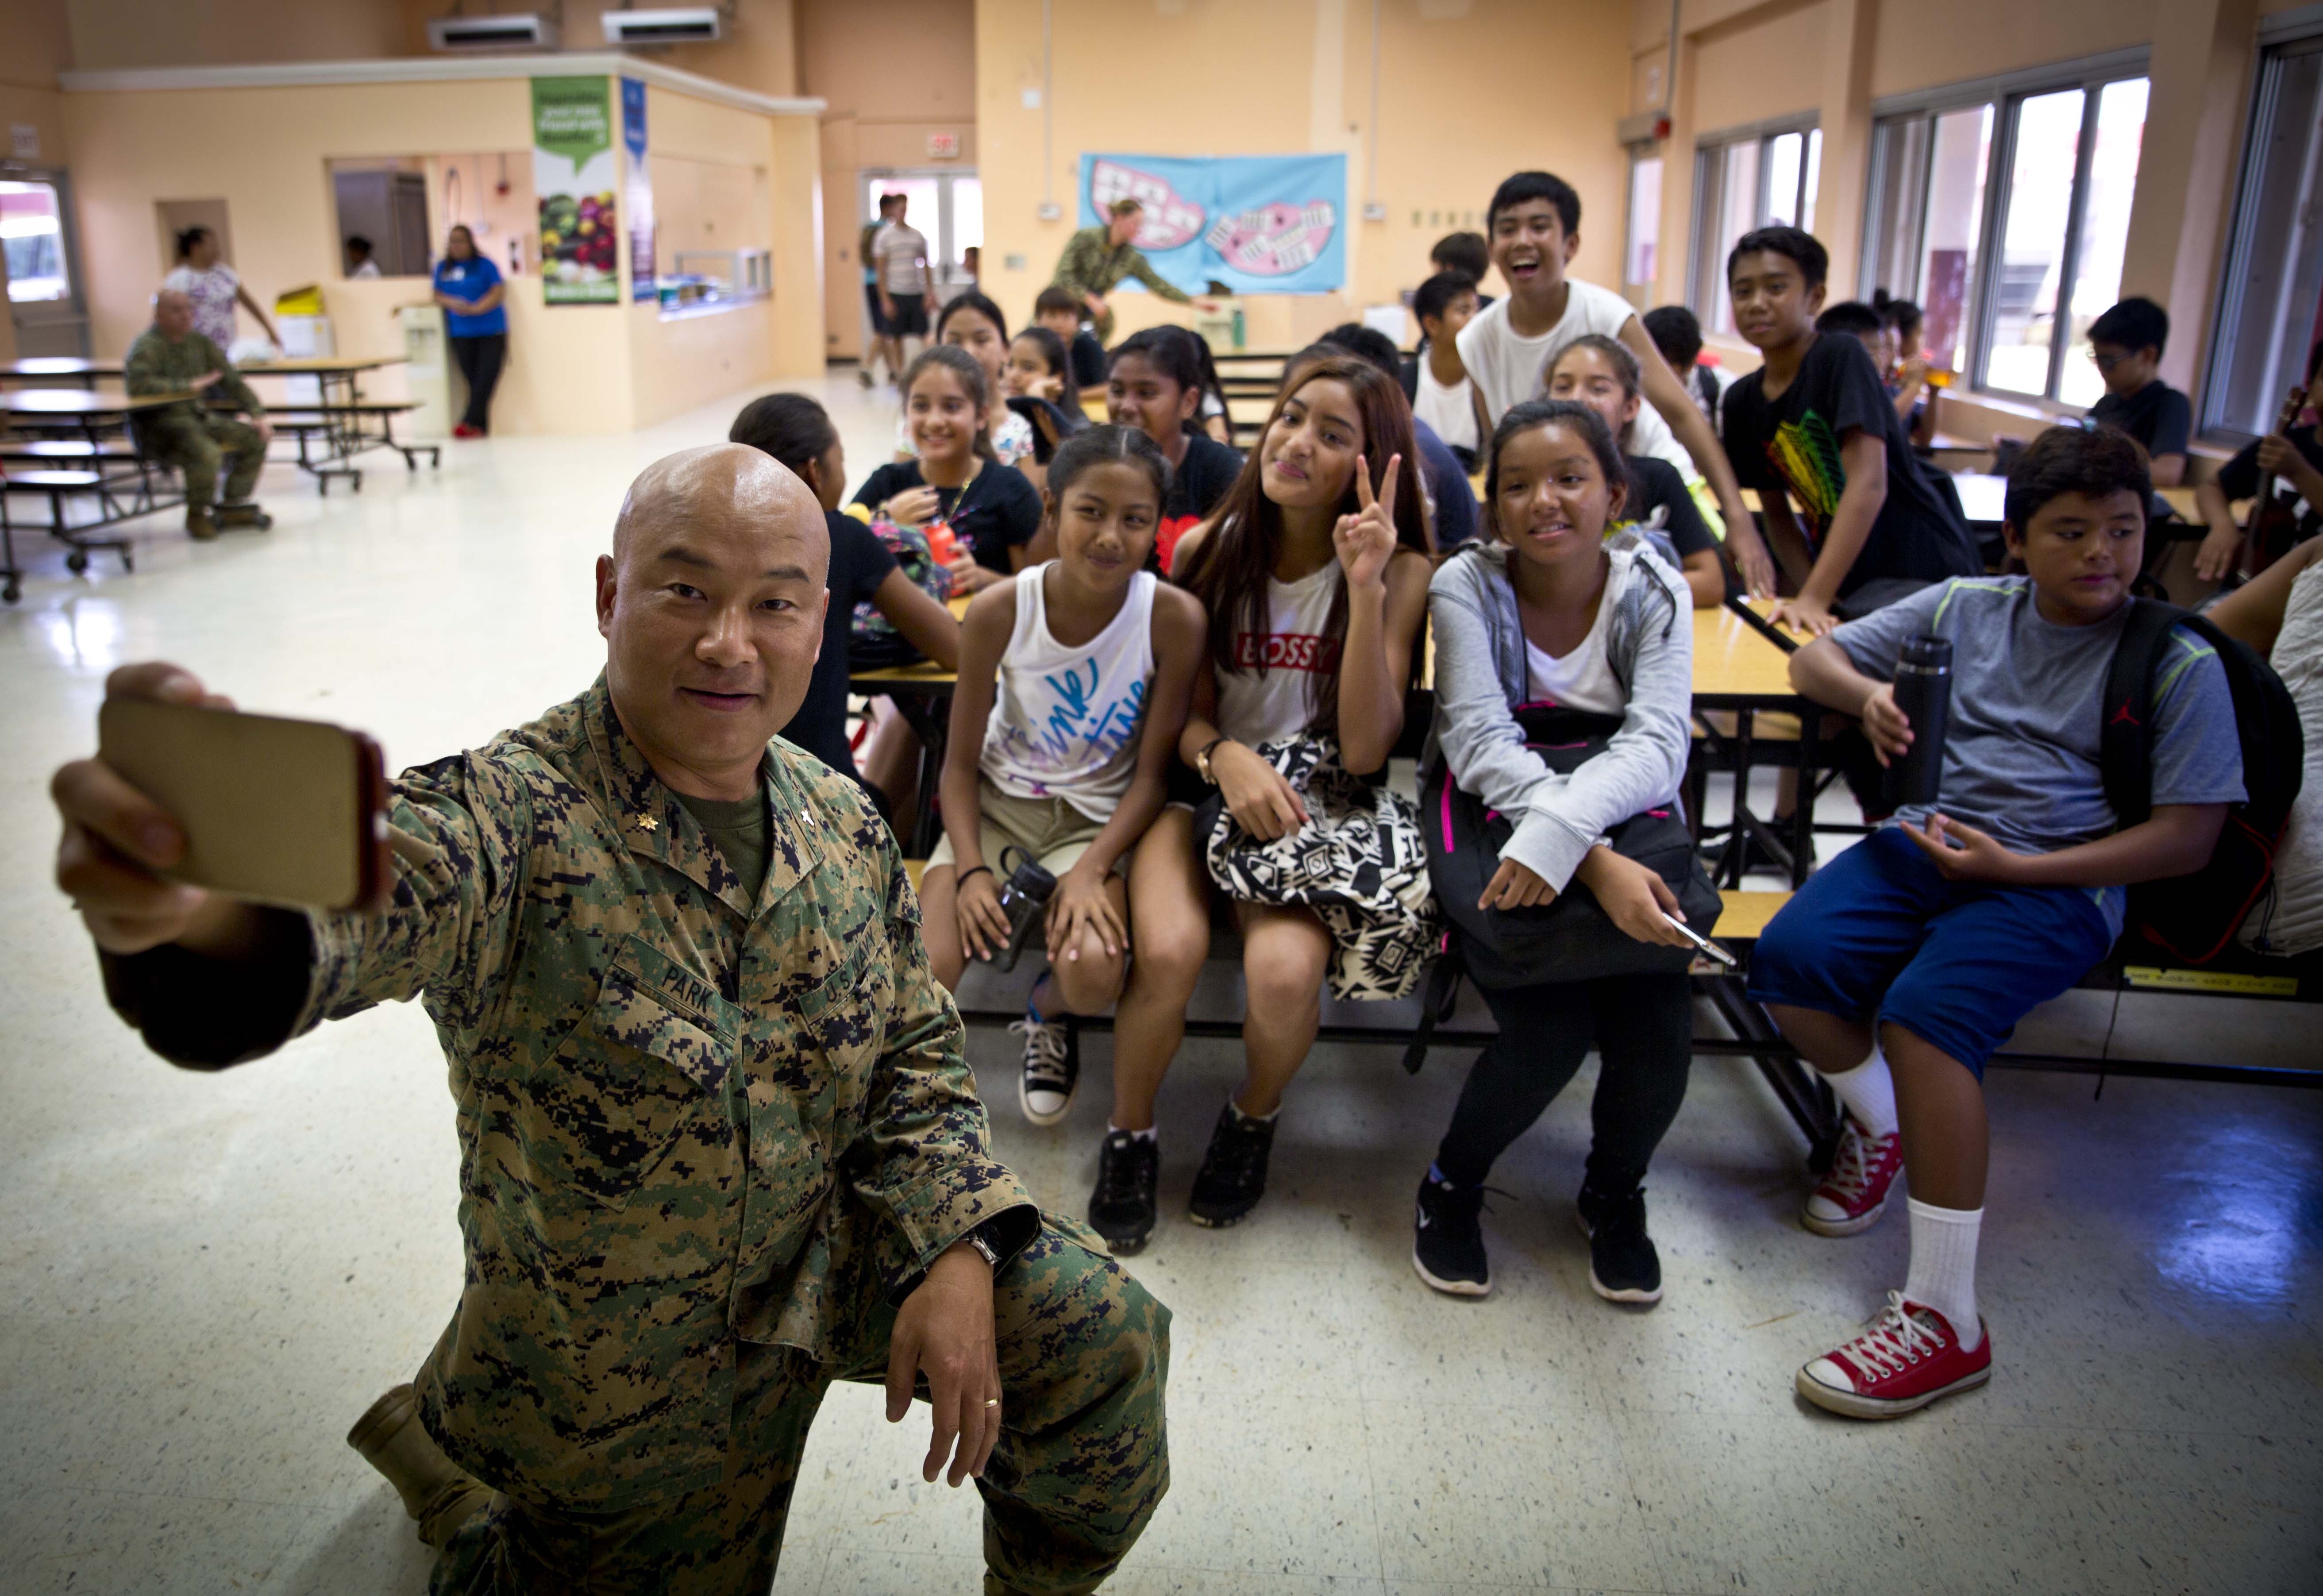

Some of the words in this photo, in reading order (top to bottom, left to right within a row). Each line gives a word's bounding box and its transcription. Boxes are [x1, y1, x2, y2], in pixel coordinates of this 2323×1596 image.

[662, 965, 714, 1014] PARK
[824, 970, 853, 1002] U.S.
[851, 925, 876, 977] NAVY
